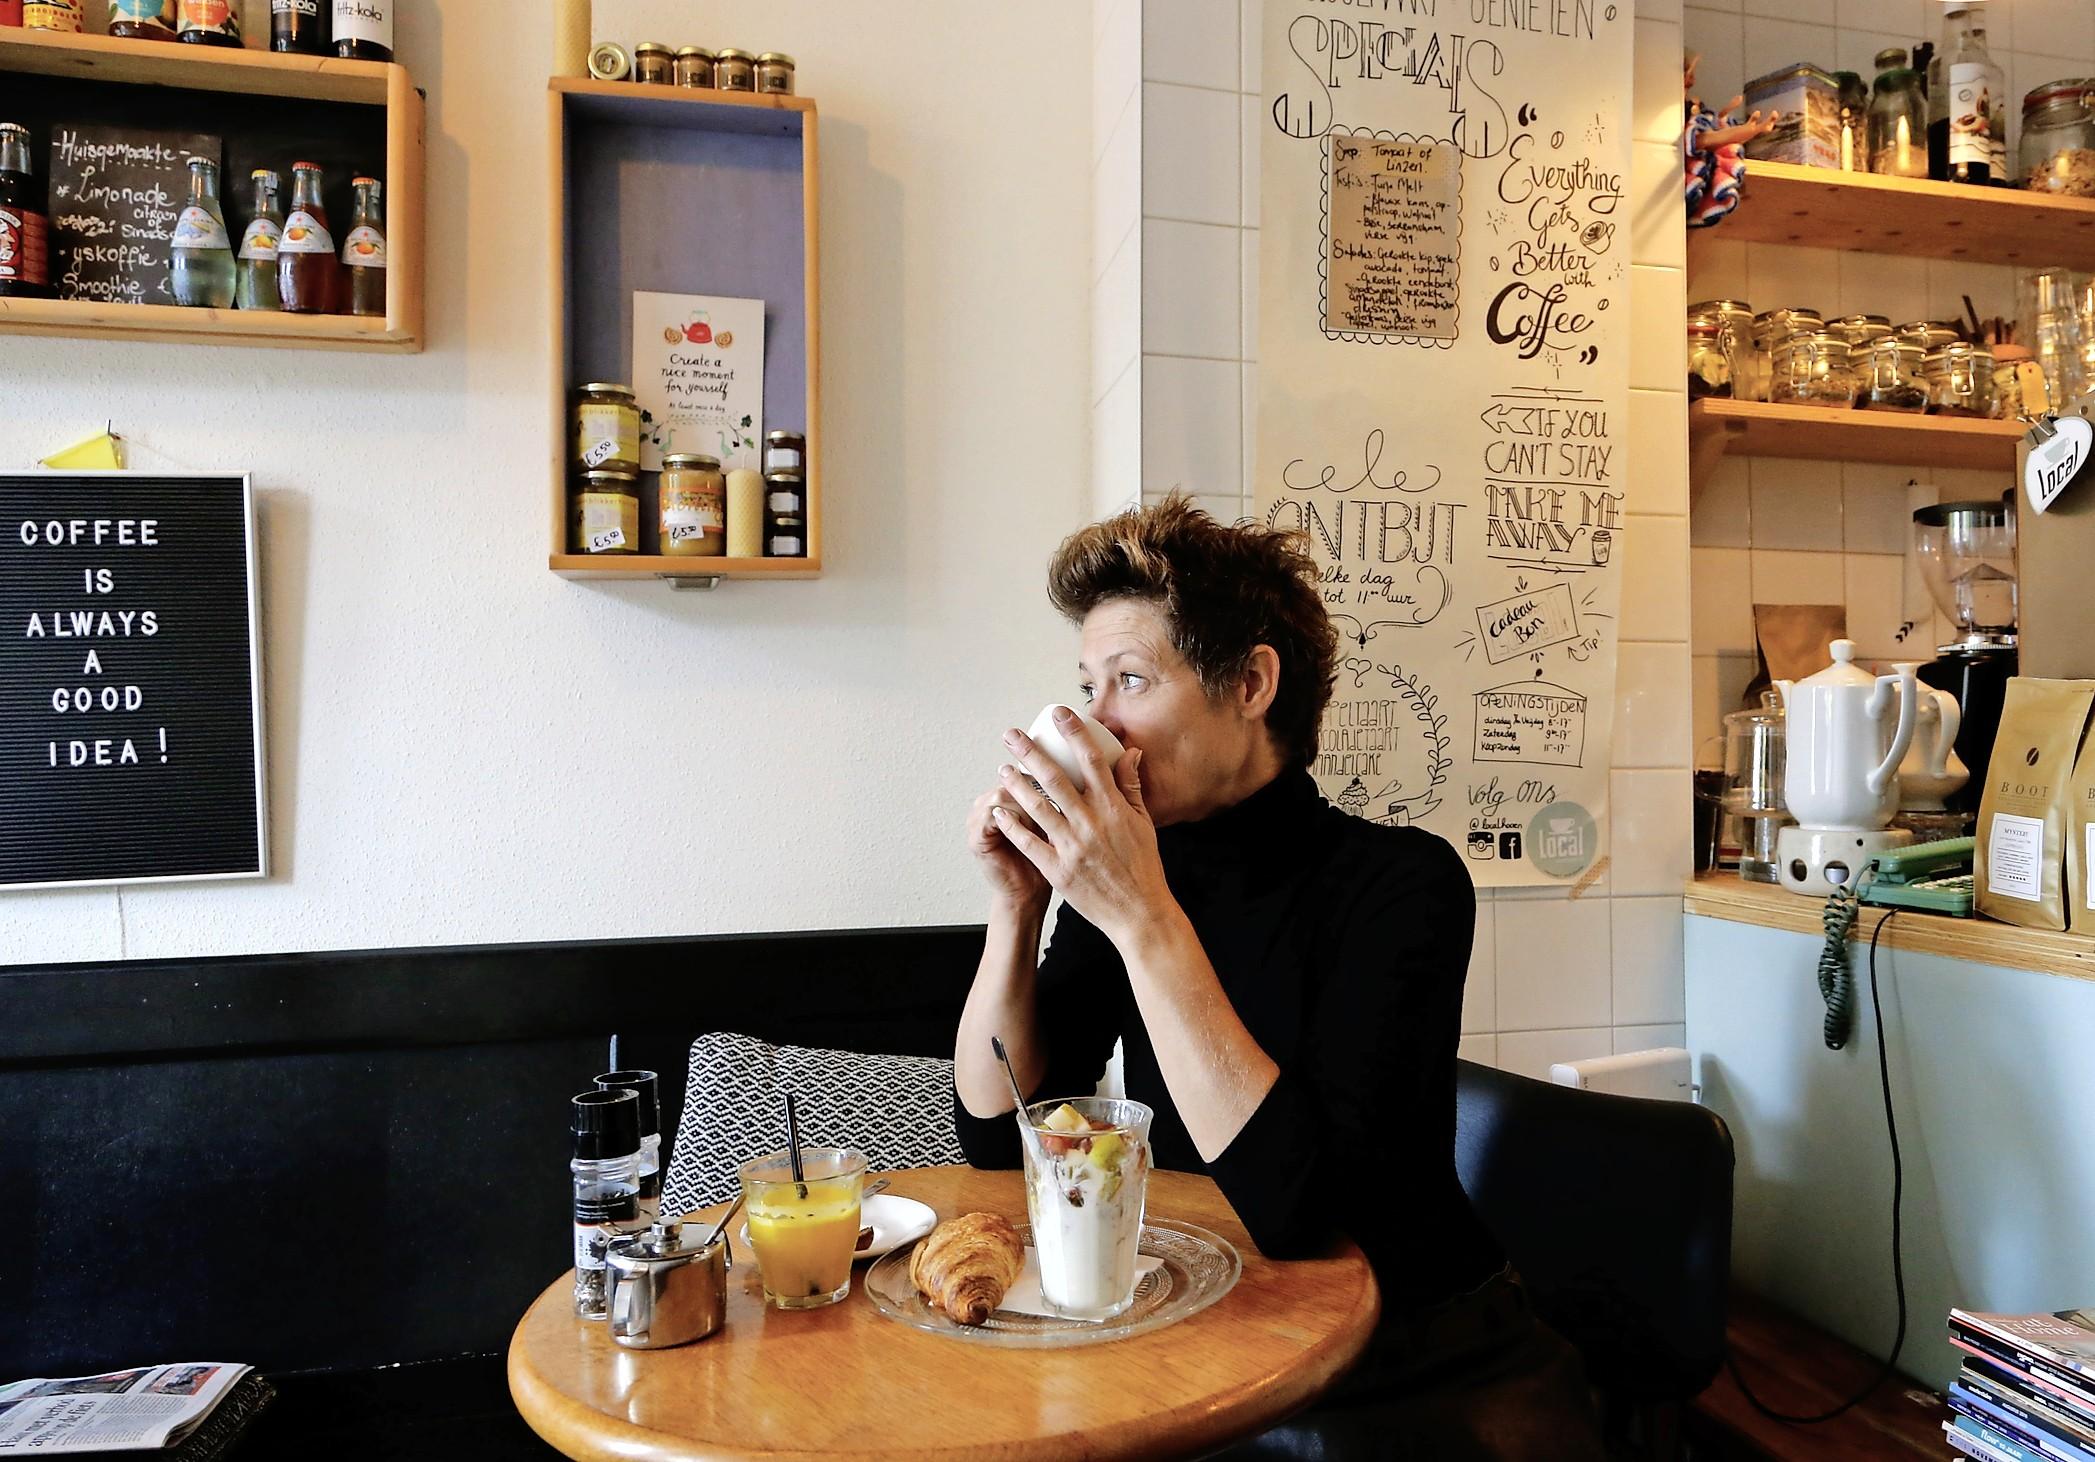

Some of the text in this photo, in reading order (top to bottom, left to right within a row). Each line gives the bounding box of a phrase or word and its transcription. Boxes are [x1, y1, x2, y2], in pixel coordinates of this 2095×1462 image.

[337, 2, 383, 21] fritz-kola
[1273, 15, 1508, 158] SPECIALS
[74, 165, 177, 209] Limonade
[1528, 195, 1579, 249] Gets
[1507, 240, 1597, 276] Better
[63, 273, 146, 296] Smoothie
[1563, 271, 1595, 287] with
[1487, 281, 1594, 359] Coffee
[669, 353, 722, 367] Create a
[661, 367, 735, 381] nice moment
[665, 379, 729, 401] for yourself
[1535, 407, 1609, 438] IF YOU
[1484, 440, 1612, 480] CAN'T STAY
[1484, 484, 1625, 529] TAKE ME
[20, 520, 159, 546] COFFEE
[1486, 518, 1587, 552] AWAY
[85, 568, 115, 594] IS
[1319, 565, 1395, 596] elke dag
[1323, 585, 1346, 604] tot
[1386, 591, 1416, 605] uur
[26, 611, 159, 638] ALWAYS
[1512, 617, 1545, 645] Bon
[84, 649, 102, 674] A
[52, 685, 143, 713] GOOD
[2001, 781, 2049, 798] BOOT
[1980, 1429, 1999, 1446] flow
